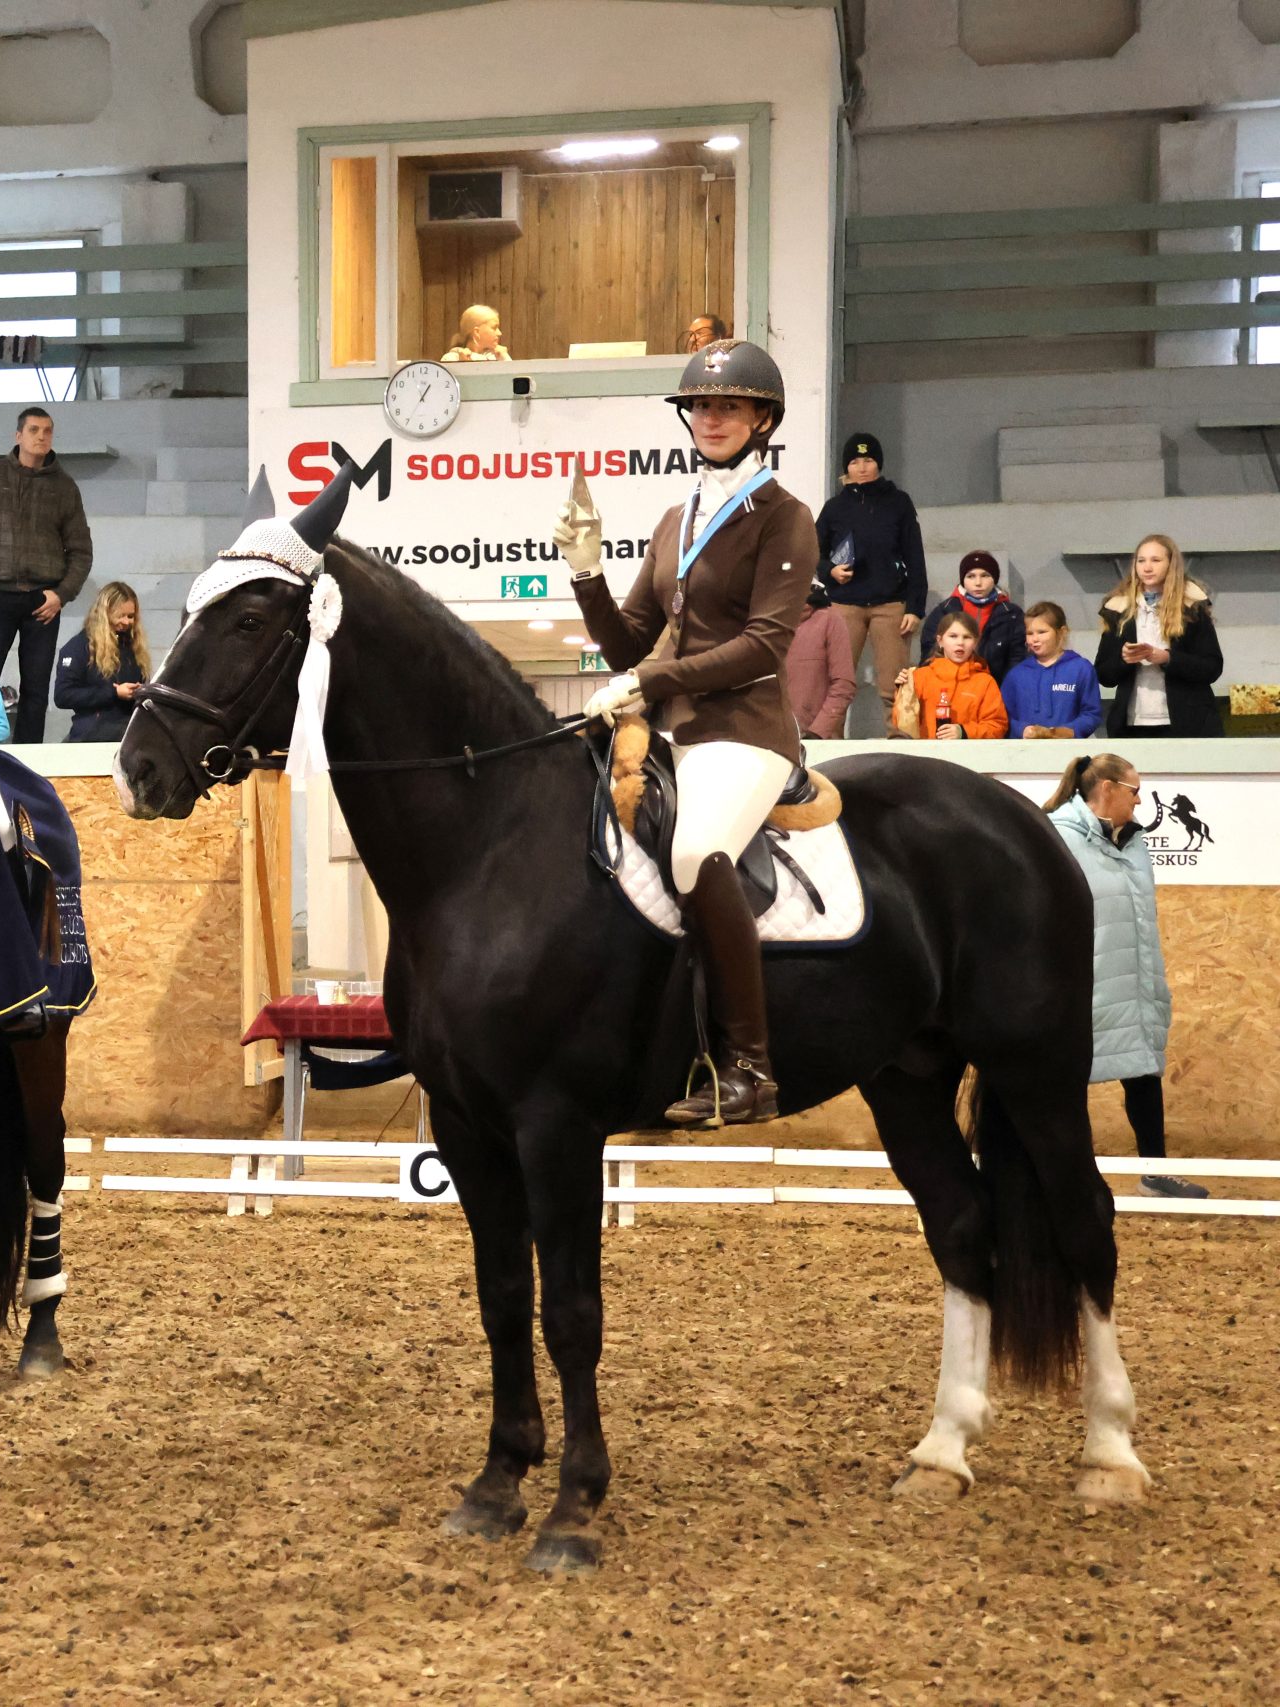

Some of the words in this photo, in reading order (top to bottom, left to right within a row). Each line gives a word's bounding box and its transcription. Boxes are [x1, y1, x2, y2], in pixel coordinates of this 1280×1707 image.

[406, 370, 415, 378] 11
[419, 366, 429, 375] 12
[436, 370, 440, 378] 1
[395, 380, 405, 388] 10
[444, 380, 450, 389] 2
[391, 394, 397, 402] 9
[449, 394, 454, 402] 3
[395, 408, 401, 416] 8
[443, 408, 449, 416] 4
[404, 418, 410, 427] 7
[418, 422, 424, 430] 6
[433, 418, 438, 426] 5
[409, 1150, 451, 1198] C
